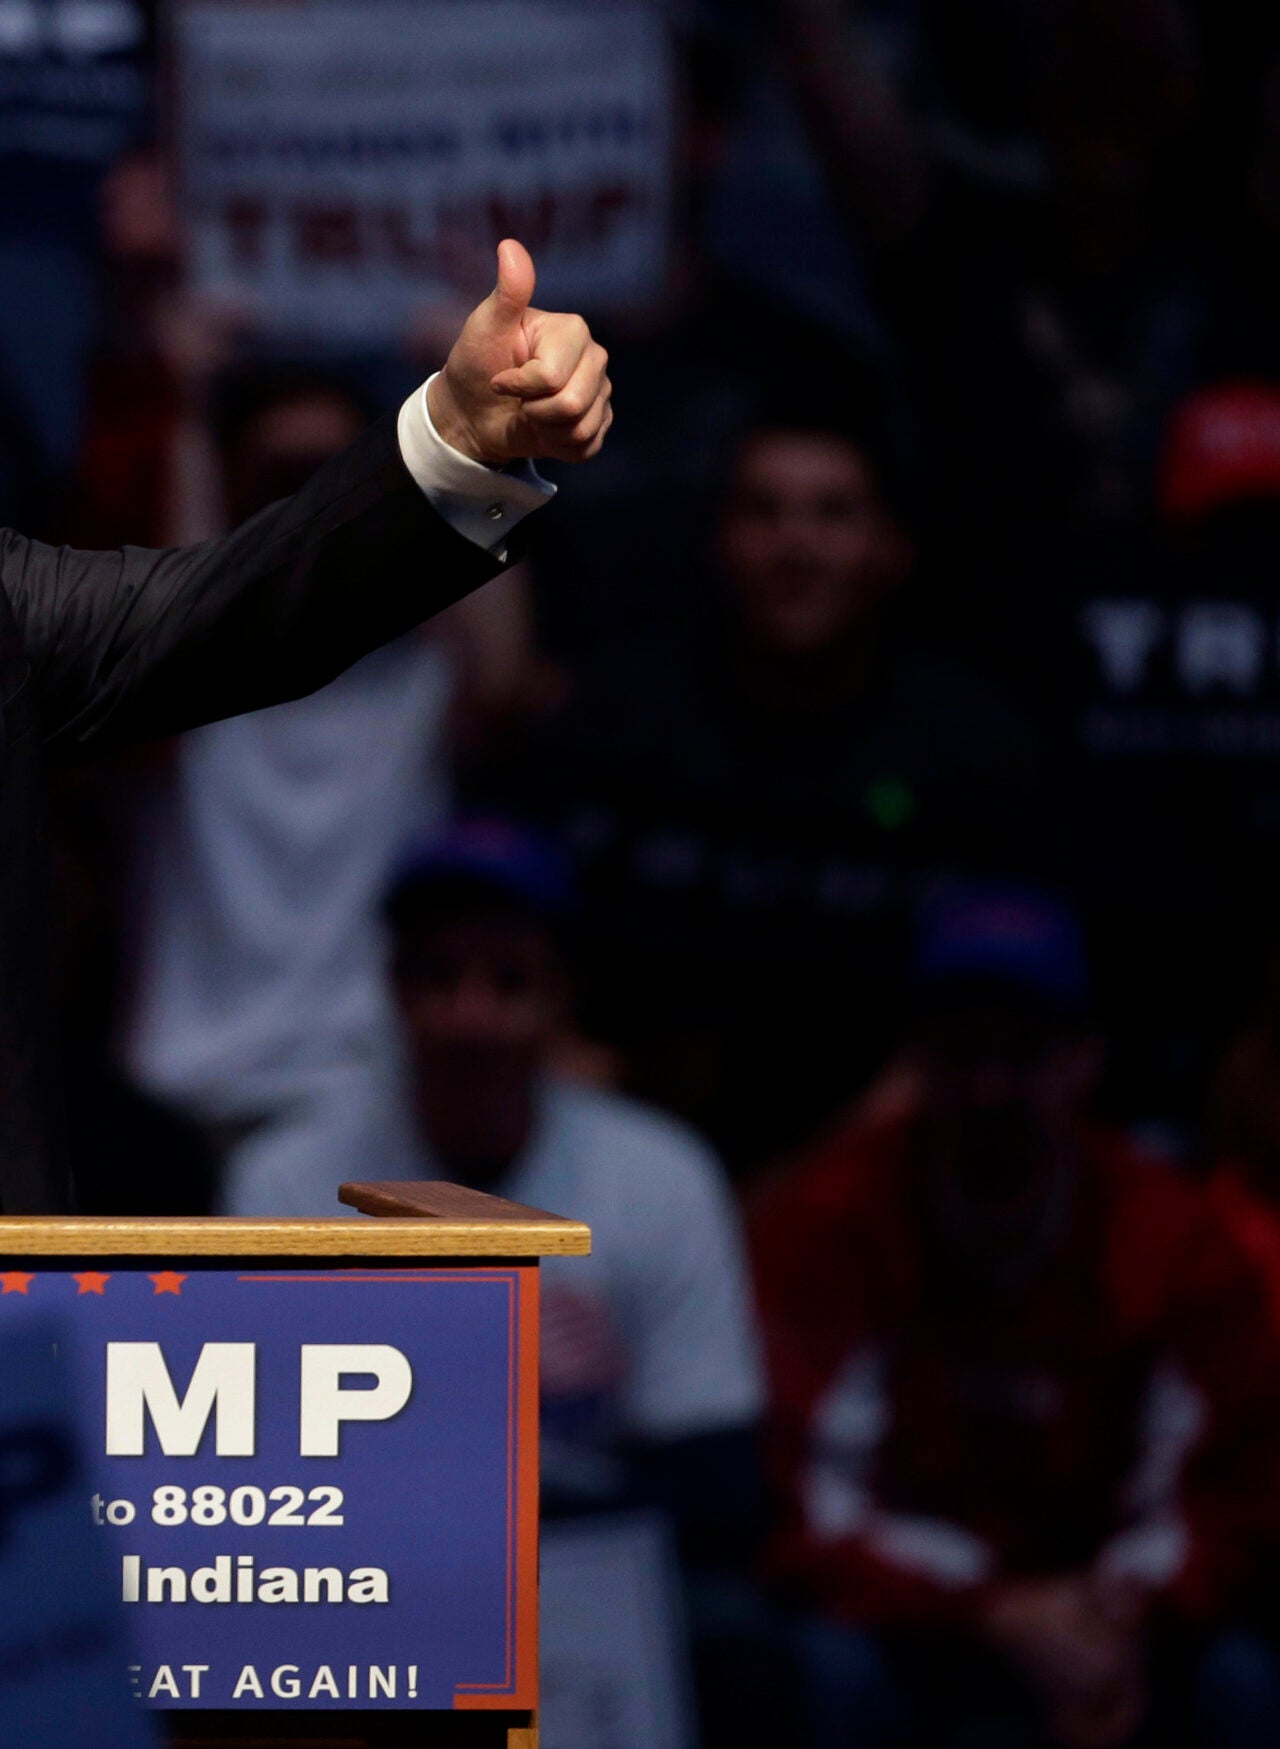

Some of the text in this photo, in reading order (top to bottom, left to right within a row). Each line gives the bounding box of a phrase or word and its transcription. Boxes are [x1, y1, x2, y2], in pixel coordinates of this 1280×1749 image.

[91, 1485, 344, 1526] to 88022
[122, 1555, 389, 1603] Indiana
[232, 1664, 418, 1699] AGAIN!
